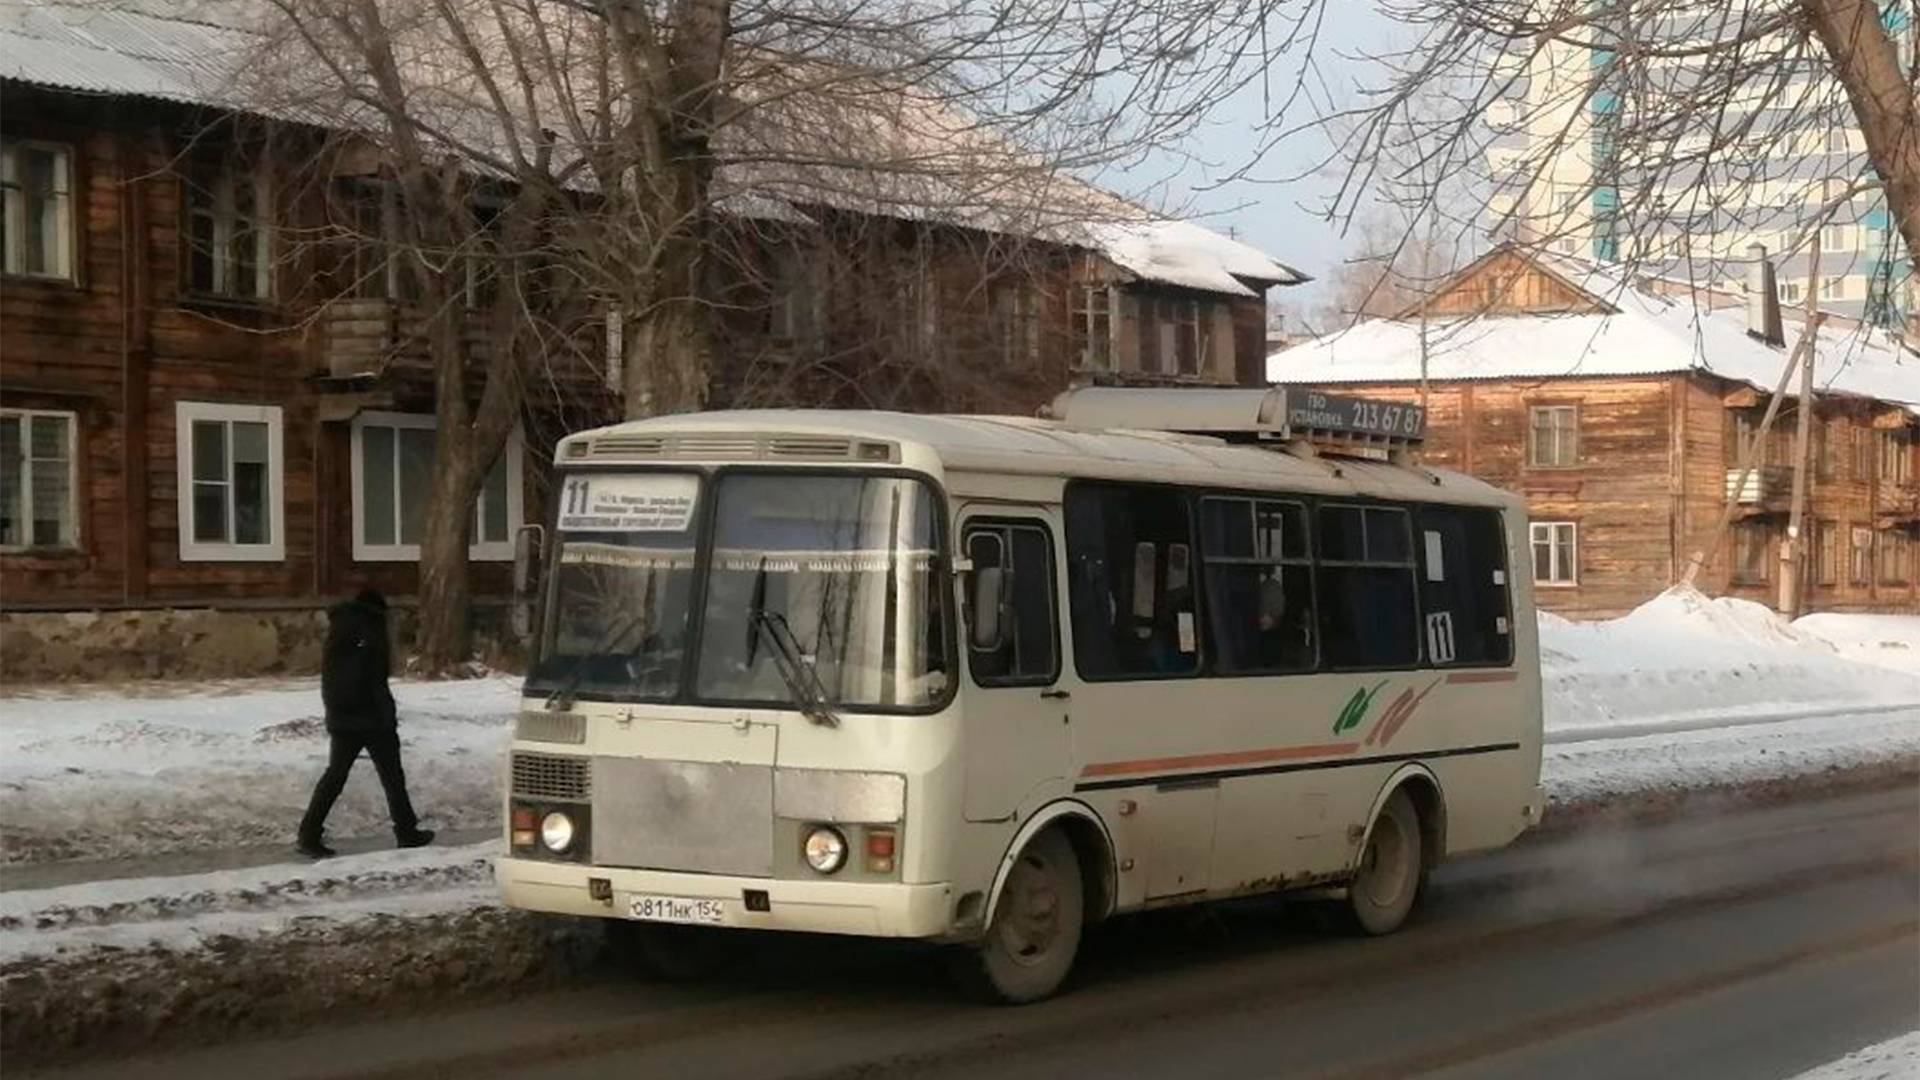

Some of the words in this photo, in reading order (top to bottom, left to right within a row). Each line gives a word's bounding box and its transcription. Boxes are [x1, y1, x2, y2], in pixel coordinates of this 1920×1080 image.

[1352, 401, 1378, 429] 213
[1382, 406, 1402, 431] 67
[1404, 409, 1422, 434] 87
[567, 481, 589, 514] 11
[1431, 614, 1452, 660] 11
